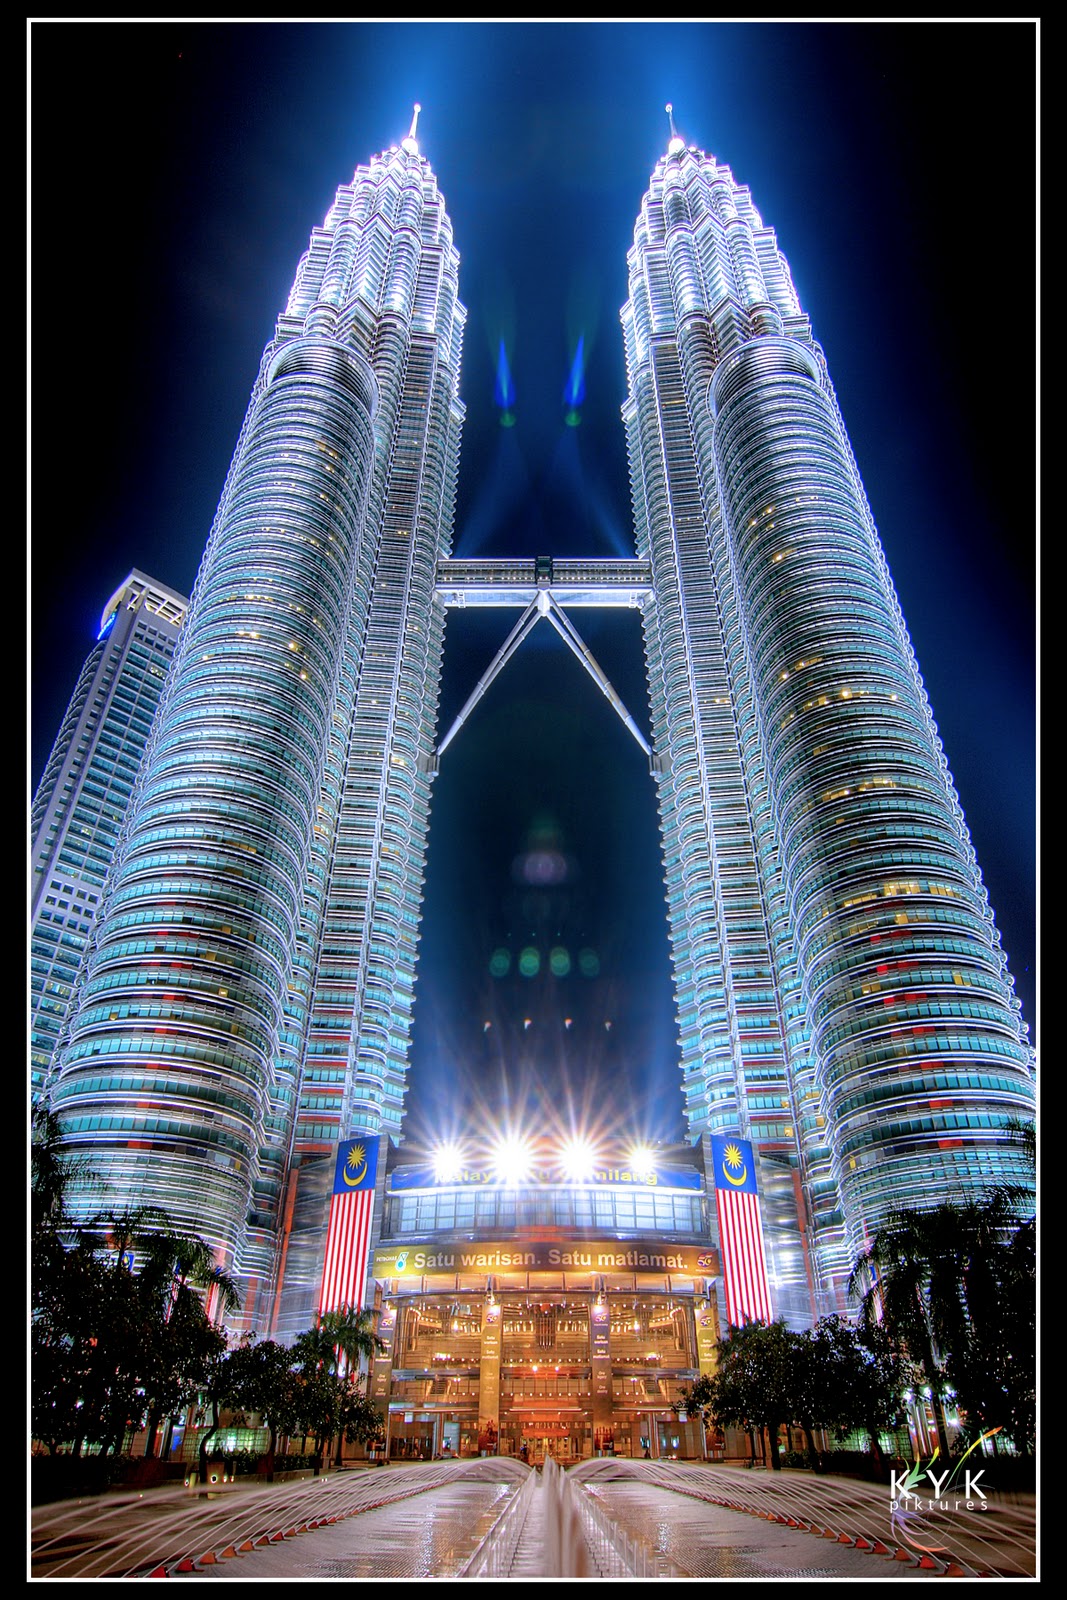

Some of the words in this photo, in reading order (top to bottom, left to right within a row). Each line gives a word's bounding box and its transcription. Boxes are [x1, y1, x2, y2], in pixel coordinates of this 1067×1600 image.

[413, 1252, 455, 1269] Satu
[461, 1250, 541, 1266] warisan.
[548, 1249, 591, 1266] Satu
[598, 1250, 688, 1269] matlamat.
